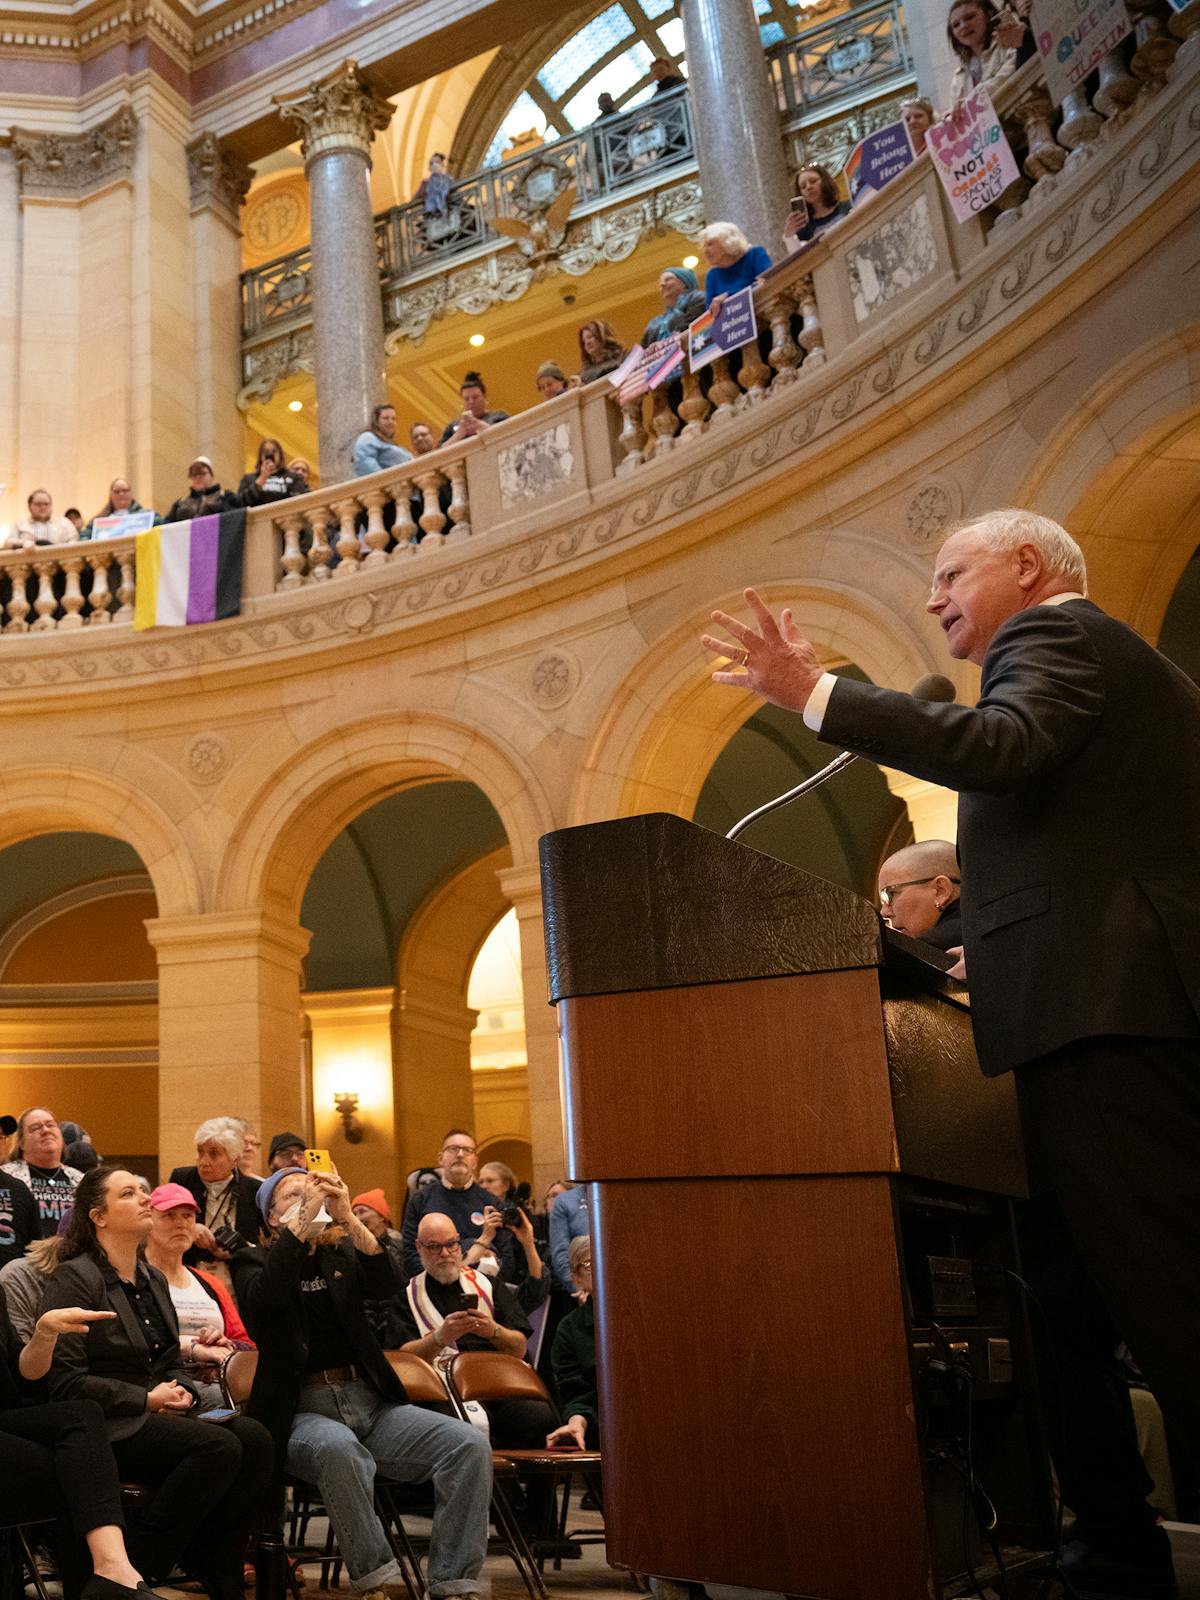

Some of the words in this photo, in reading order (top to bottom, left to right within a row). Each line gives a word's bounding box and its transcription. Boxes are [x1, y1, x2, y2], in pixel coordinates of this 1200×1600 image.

[872, 134, 896, 150] You
[970, 124, 1001, 155] CLUB
[871, 144, 908, 170] Belong
[954, 152, 986, 181] NOT
[880, 161, 905, 181] Here
[952, 153, 1000, 198] ORANGE
[961, 165, 1002, 204] JACKASS
[969, 179, 1004, 212] CULT
[725, 301, 743, 315] You
[721, 312, 750, 332] Belong
[727, 327, 747, 343] Here
[32, 1192, 75, 1201] HROUG
